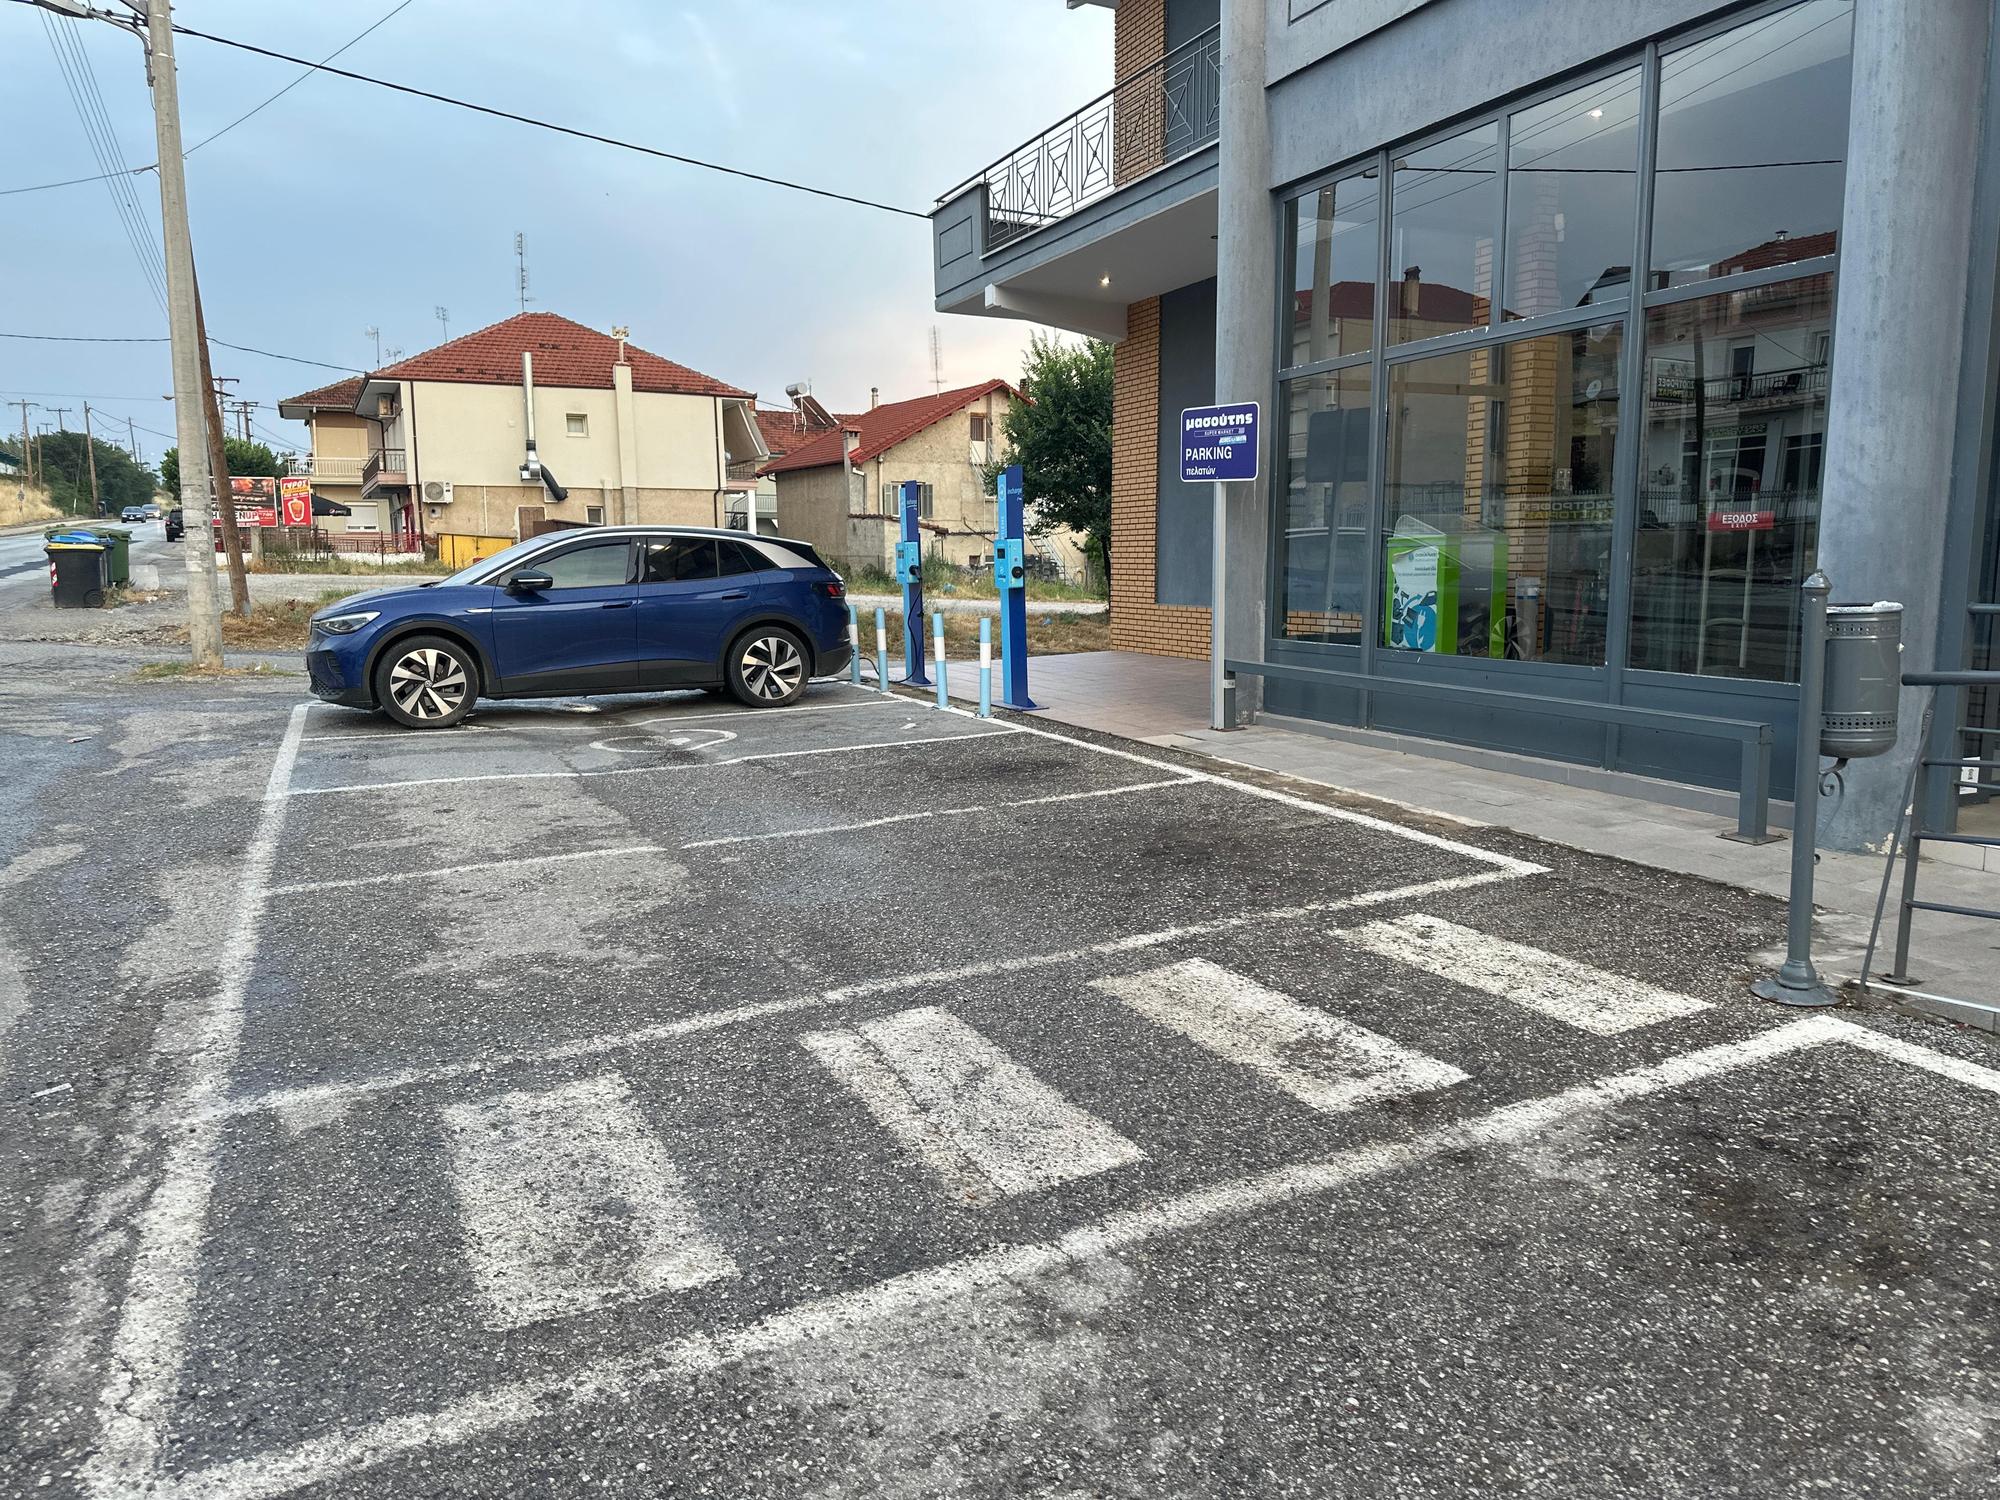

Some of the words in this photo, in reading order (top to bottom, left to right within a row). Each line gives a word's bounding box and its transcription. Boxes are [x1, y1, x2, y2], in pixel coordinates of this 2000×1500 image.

[1186, 413, 1253, 431] μασούτης
[1185, 446, 1232, 461] PARKING
[1186, 465, 1216, 475] πελατών
[1722, 514, 1758, 524] ΕΞΟΔΟΣ
